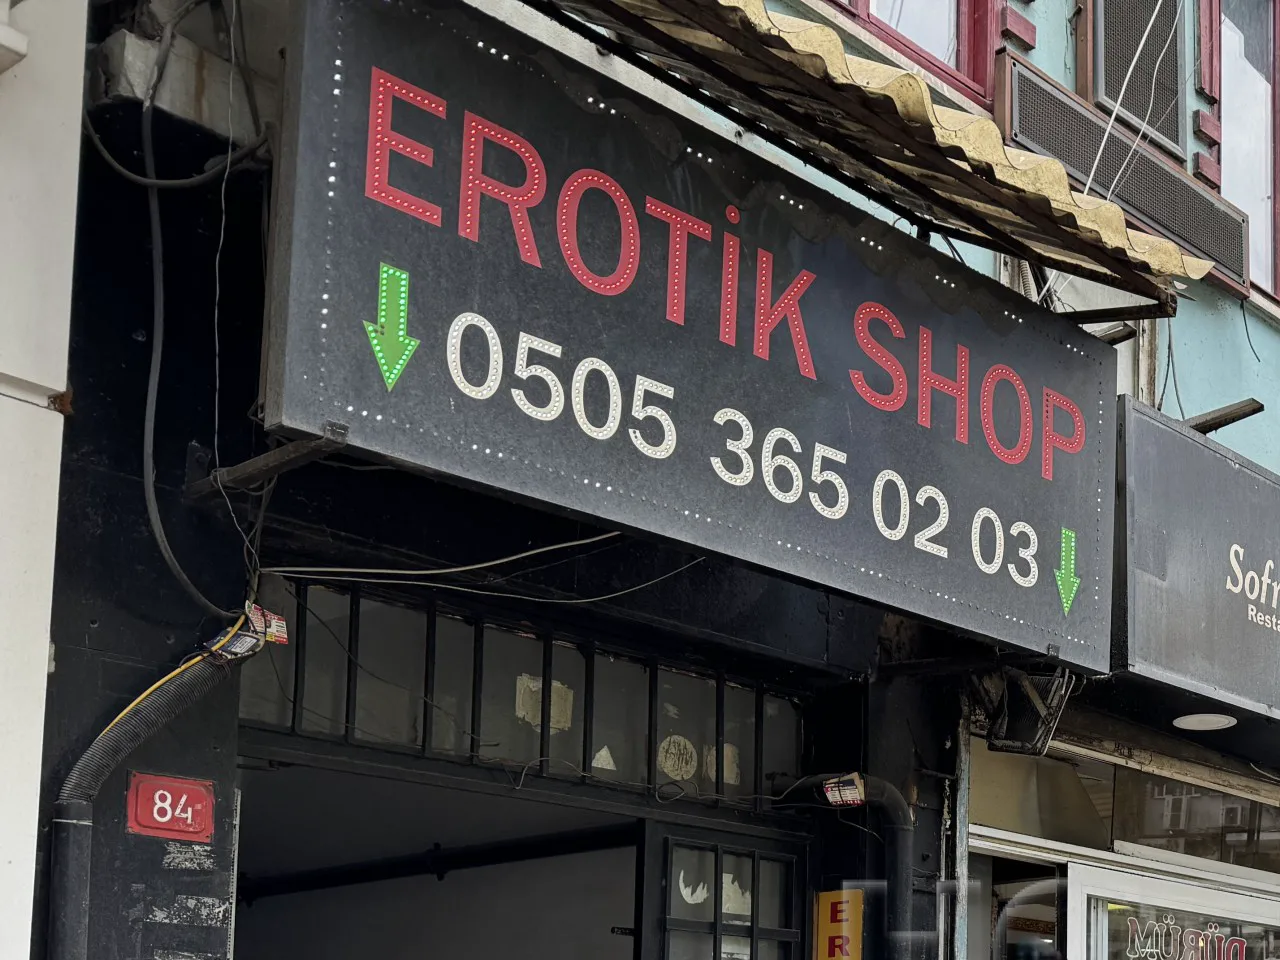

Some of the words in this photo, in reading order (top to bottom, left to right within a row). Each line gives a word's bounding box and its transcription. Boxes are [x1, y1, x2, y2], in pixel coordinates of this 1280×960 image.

[365, 66, 818, 381] EROTİK
[849, 301, 1086, 481] SHOP
[446, 312, 677, 459] 0505
[710, 407, 849, 520] 365
[872, 469, 950, 559] 02
[971, 507, 1040, 587] 03
[153, 789, 193, 824] 84
